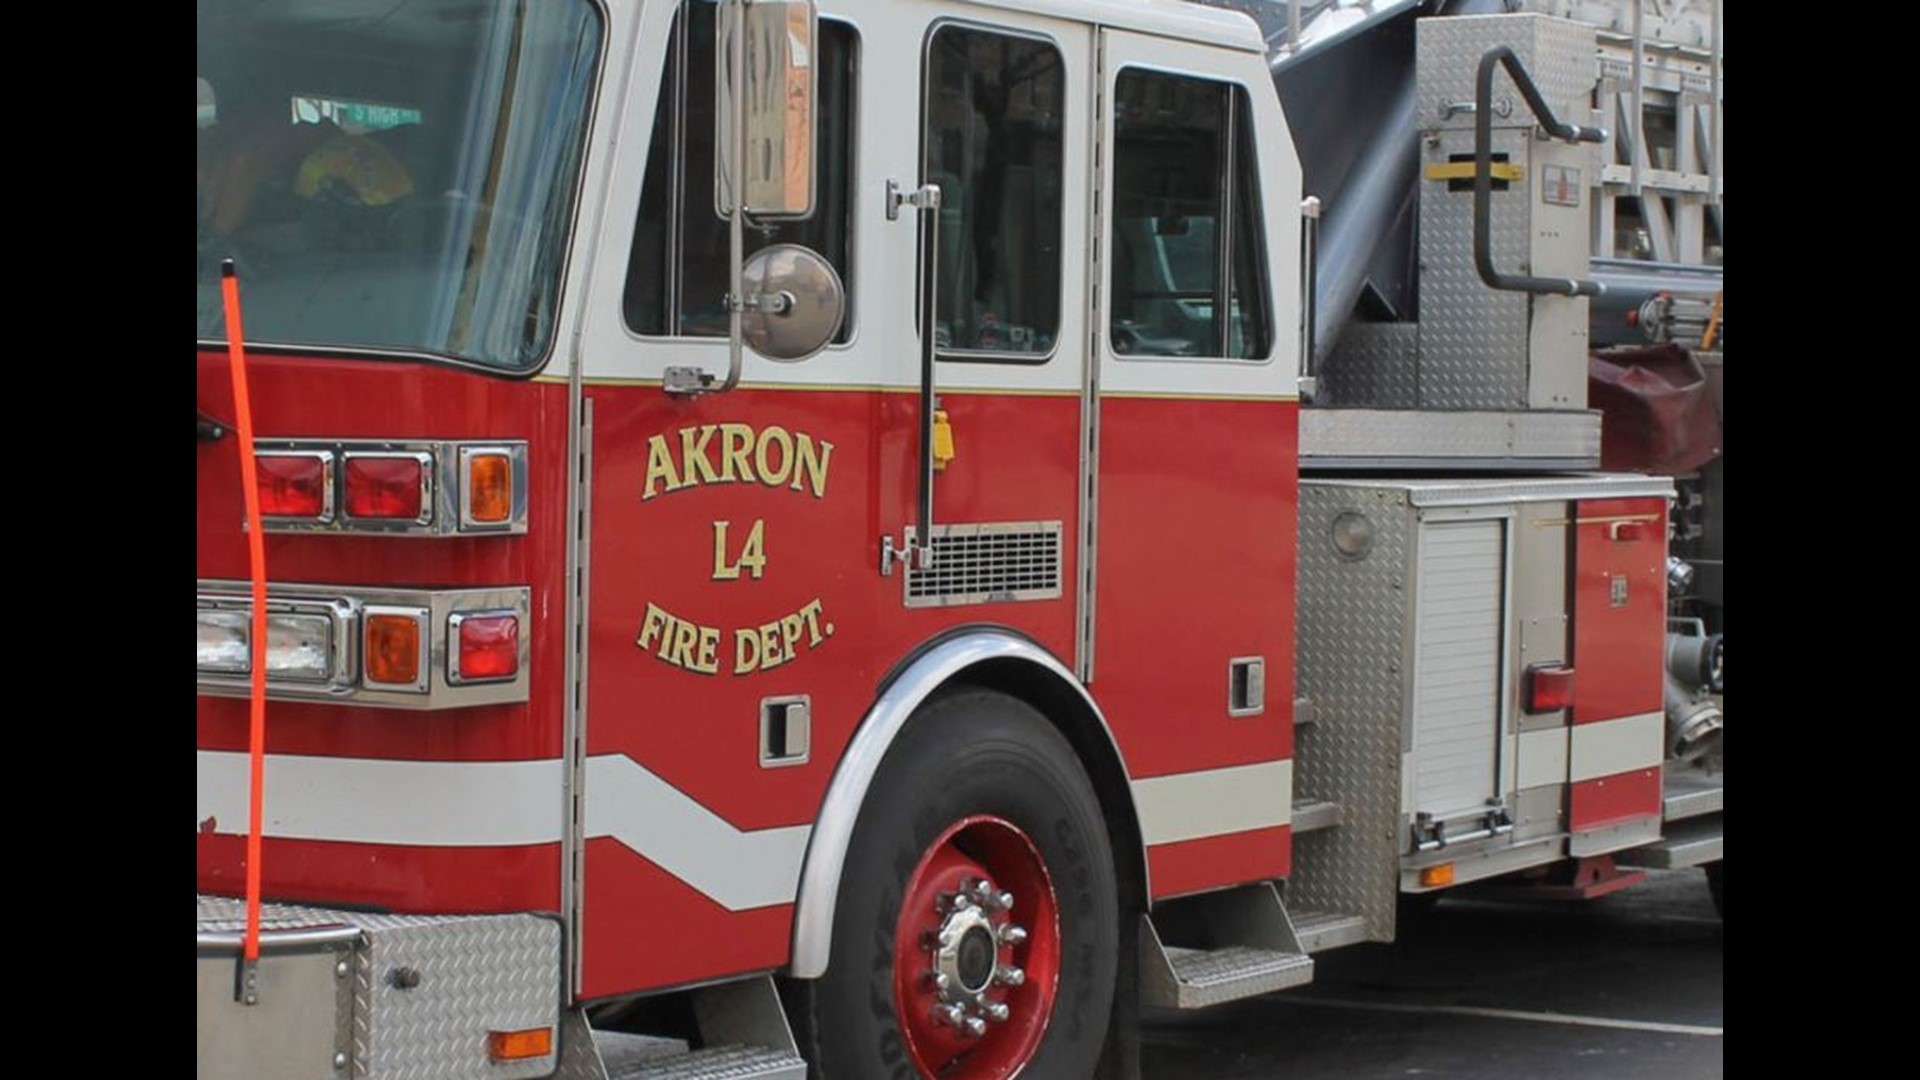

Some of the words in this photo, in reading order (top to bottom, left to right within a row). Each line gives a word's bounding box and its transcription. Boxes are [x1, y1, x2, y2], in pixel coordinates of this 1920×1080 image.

[368, 106, 399, 126] HIGH
[642, 423, 834, 500] AKRON
[712, 519, 766, 580] L4
[636, 601, 720, 674] FIRE
[733, 598, 834, 674] DEPT.
